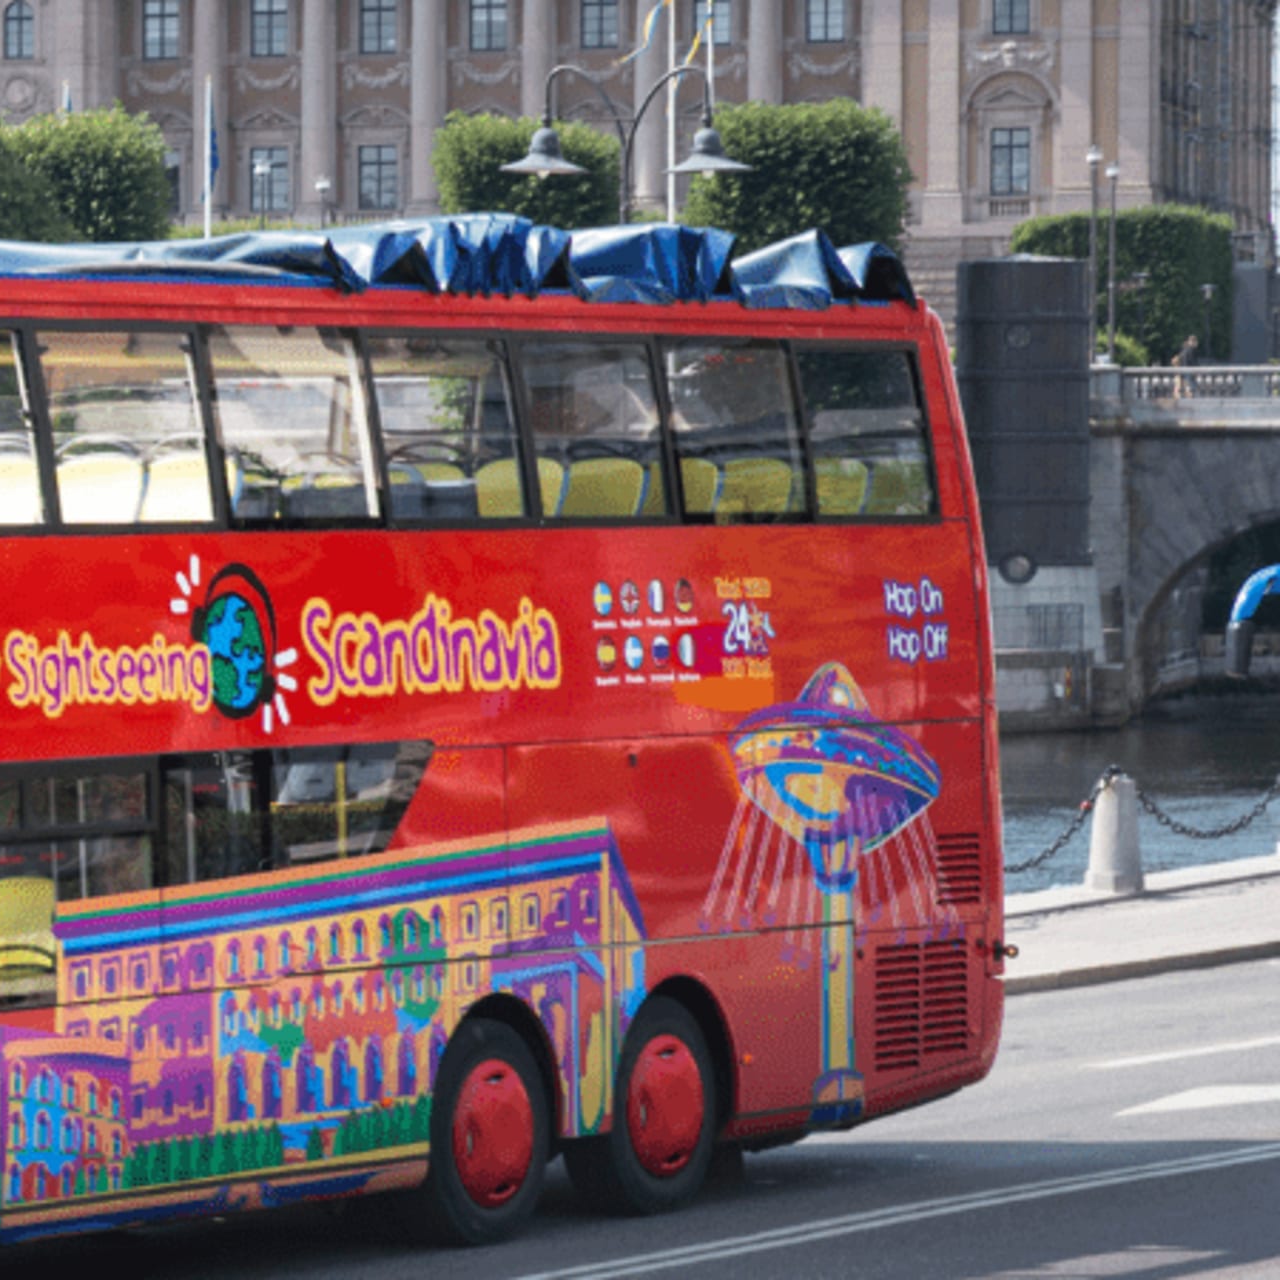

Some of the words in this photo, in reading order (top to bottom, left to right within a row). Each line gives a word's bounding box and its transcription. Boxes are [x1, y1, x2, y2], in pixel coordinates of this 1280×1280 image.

[884, 578, 918, 619] Hop
[919, 575, 944, 615] On
[4, 630, 211, 718] Sightseeing
[301, 592, 561, 705] Scandinavia
[888, 624, 921, 666] Hop
[922, 621, 948, 662] Off
